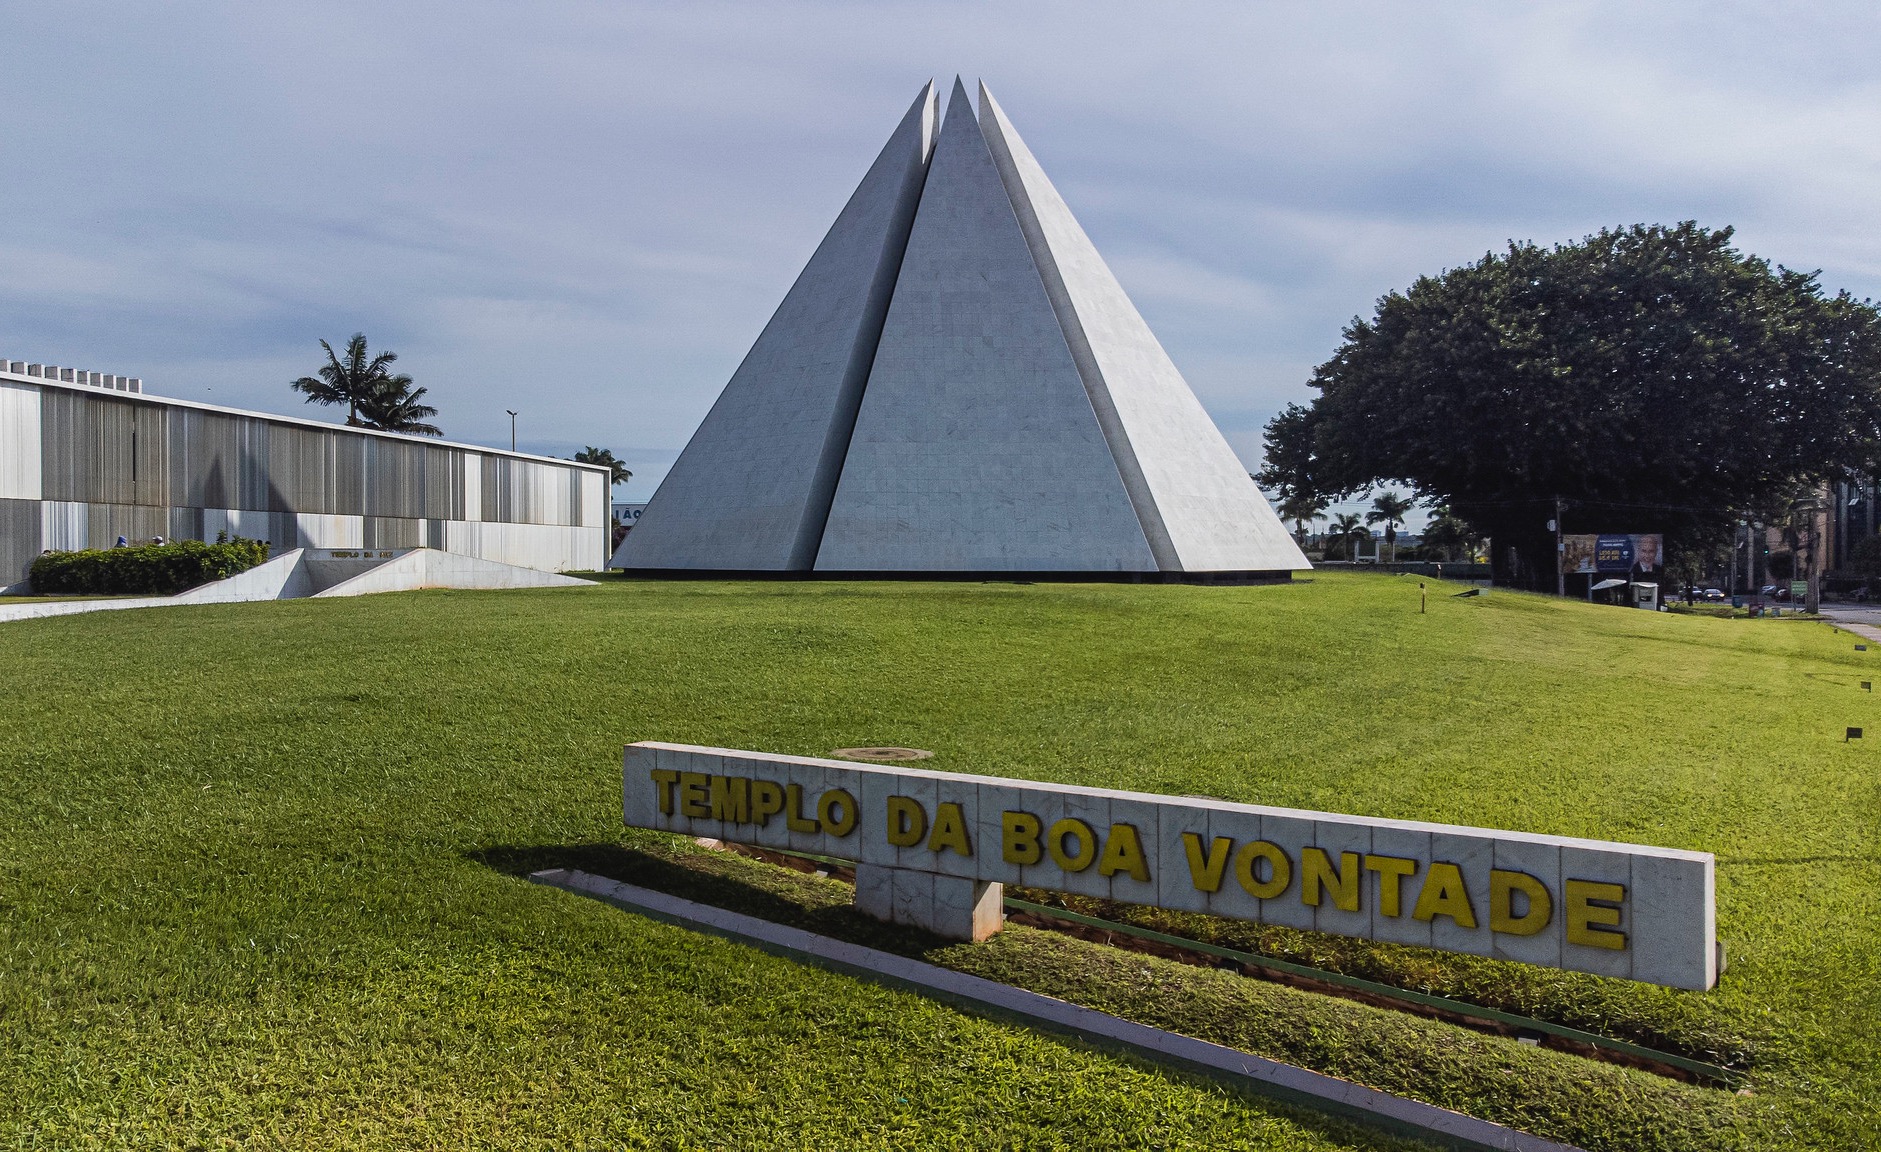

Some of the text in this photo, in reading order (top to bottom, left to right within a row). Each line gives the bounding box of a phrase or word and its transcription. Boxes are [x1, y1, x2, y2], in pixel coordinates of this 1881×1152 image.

[651, 769, 1628, 950] TEMPLO DA BOA VONTADE
